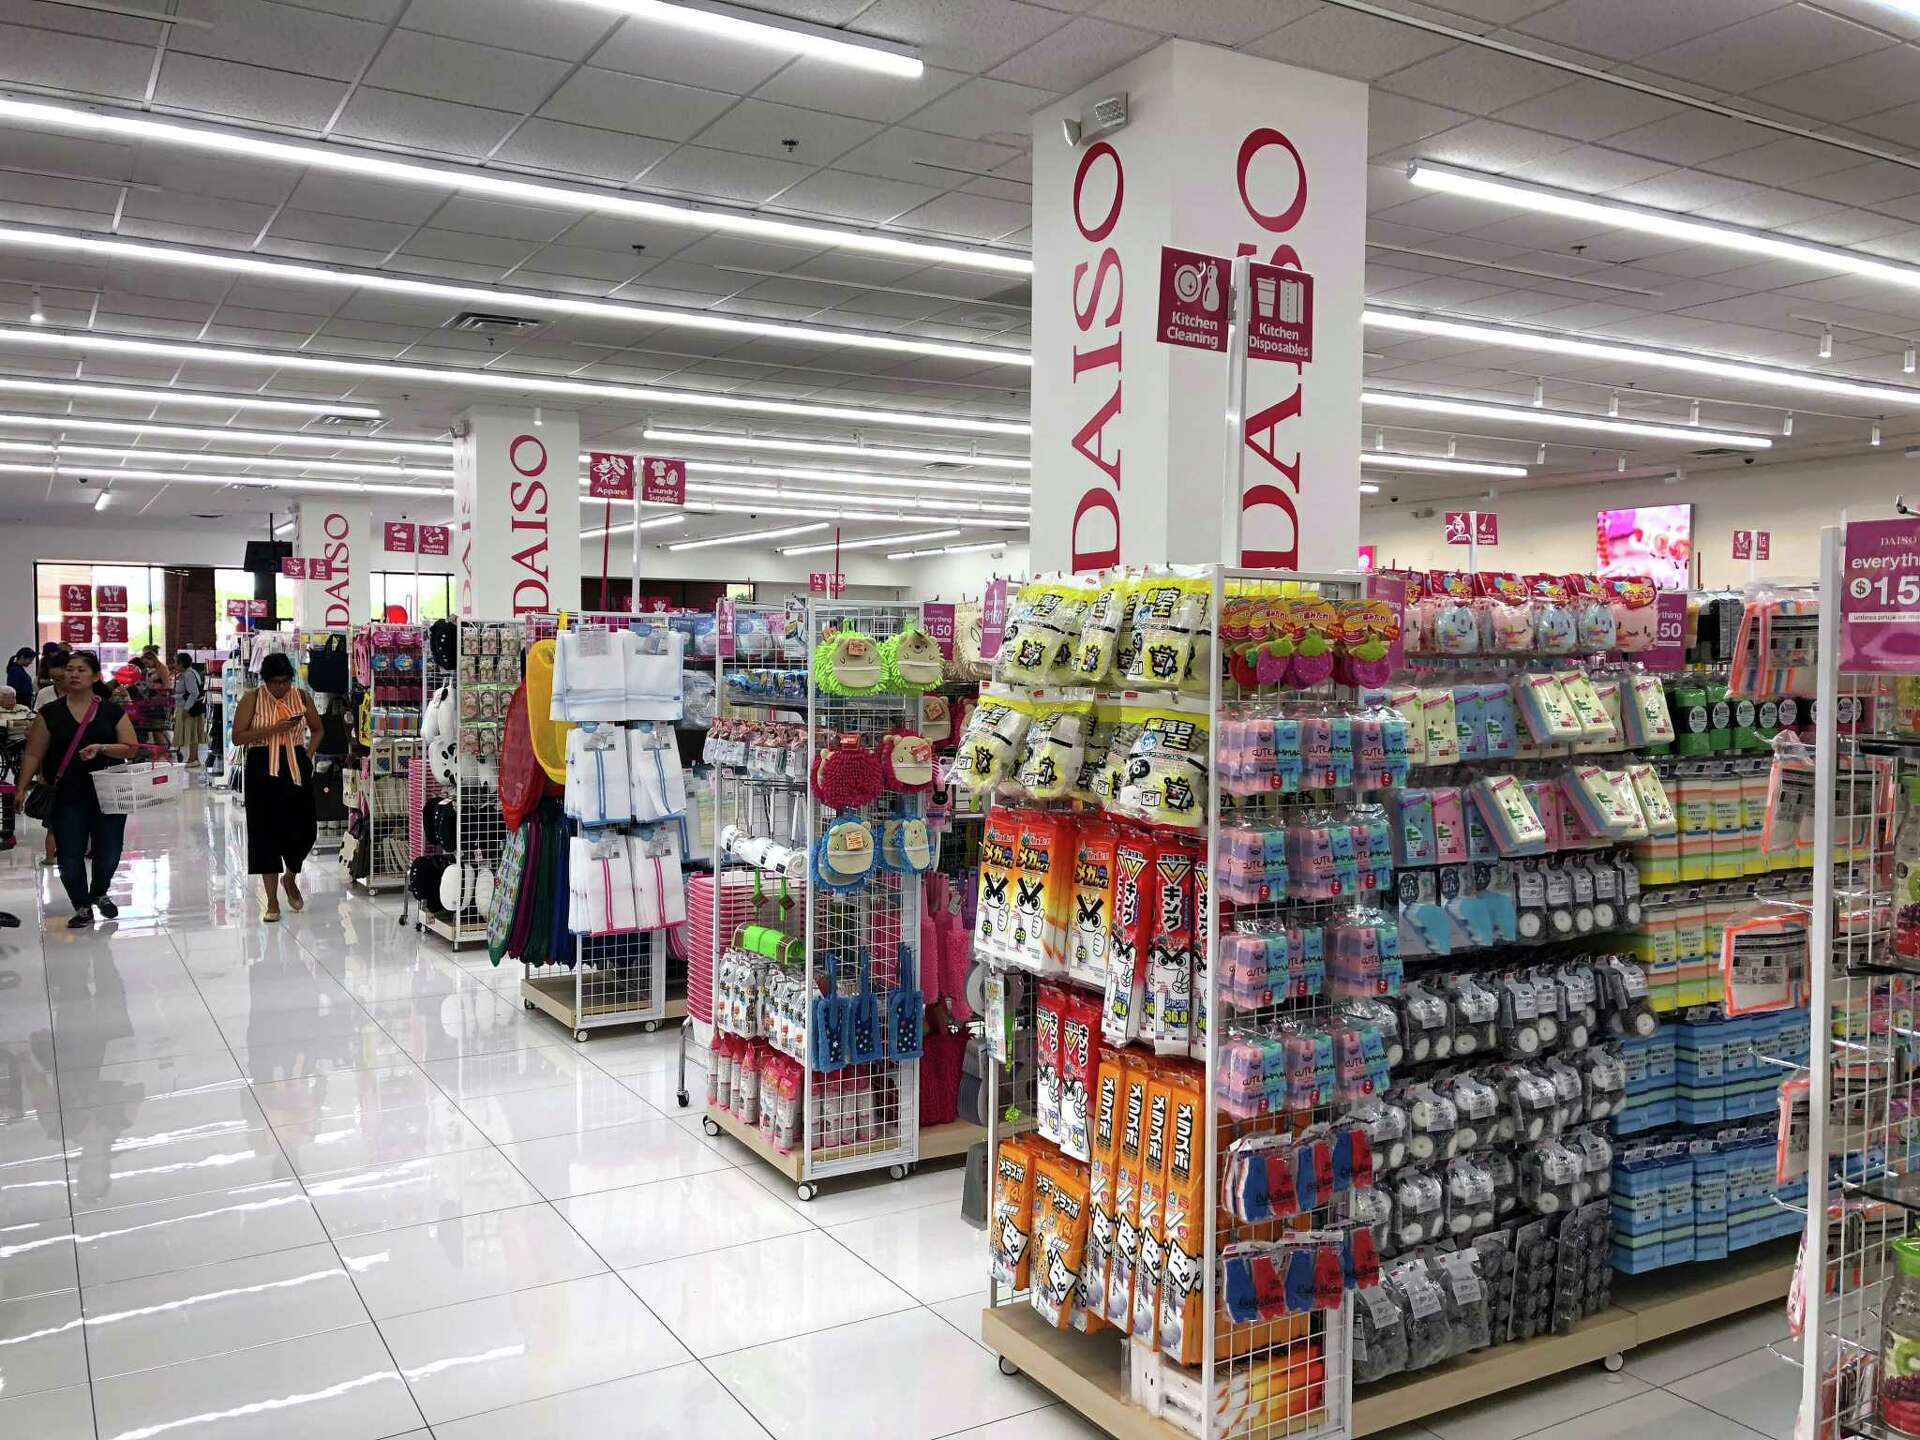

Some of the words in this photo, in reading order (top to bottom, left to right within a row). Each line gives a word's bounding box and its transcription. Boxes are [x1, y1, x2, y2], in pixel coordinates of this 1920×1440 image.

[1166, 326, 1219, 349] Cleaning
[1171, 311, 1218, 331] Kitchen
[1259, 322, 1299, 341] Kitchen
[1071, 141, 1124, 575] DAISO
[1236, 127, 1307, 571] DAO
[1249, 334, 1309, 357] Disposables
[596, 487, 628, 496] Apparel
[647, 486, 679, 497] Laundry
[649, 494, 679, 503] Supplies
[509, 434, 549, 619] DAISO
[323, 513, 351, 628] DAISO
[1124, 881, 1136, 924] キング
[1163, 885, 1180, 930] キング
[1050, 1013, 1058, 1051] キング
[1164, 1010, 1189, 1025] 36.8
[1079, 1026, 1088, 1066] キング
[1175, 1103, 1192, 1171] メラスポ
